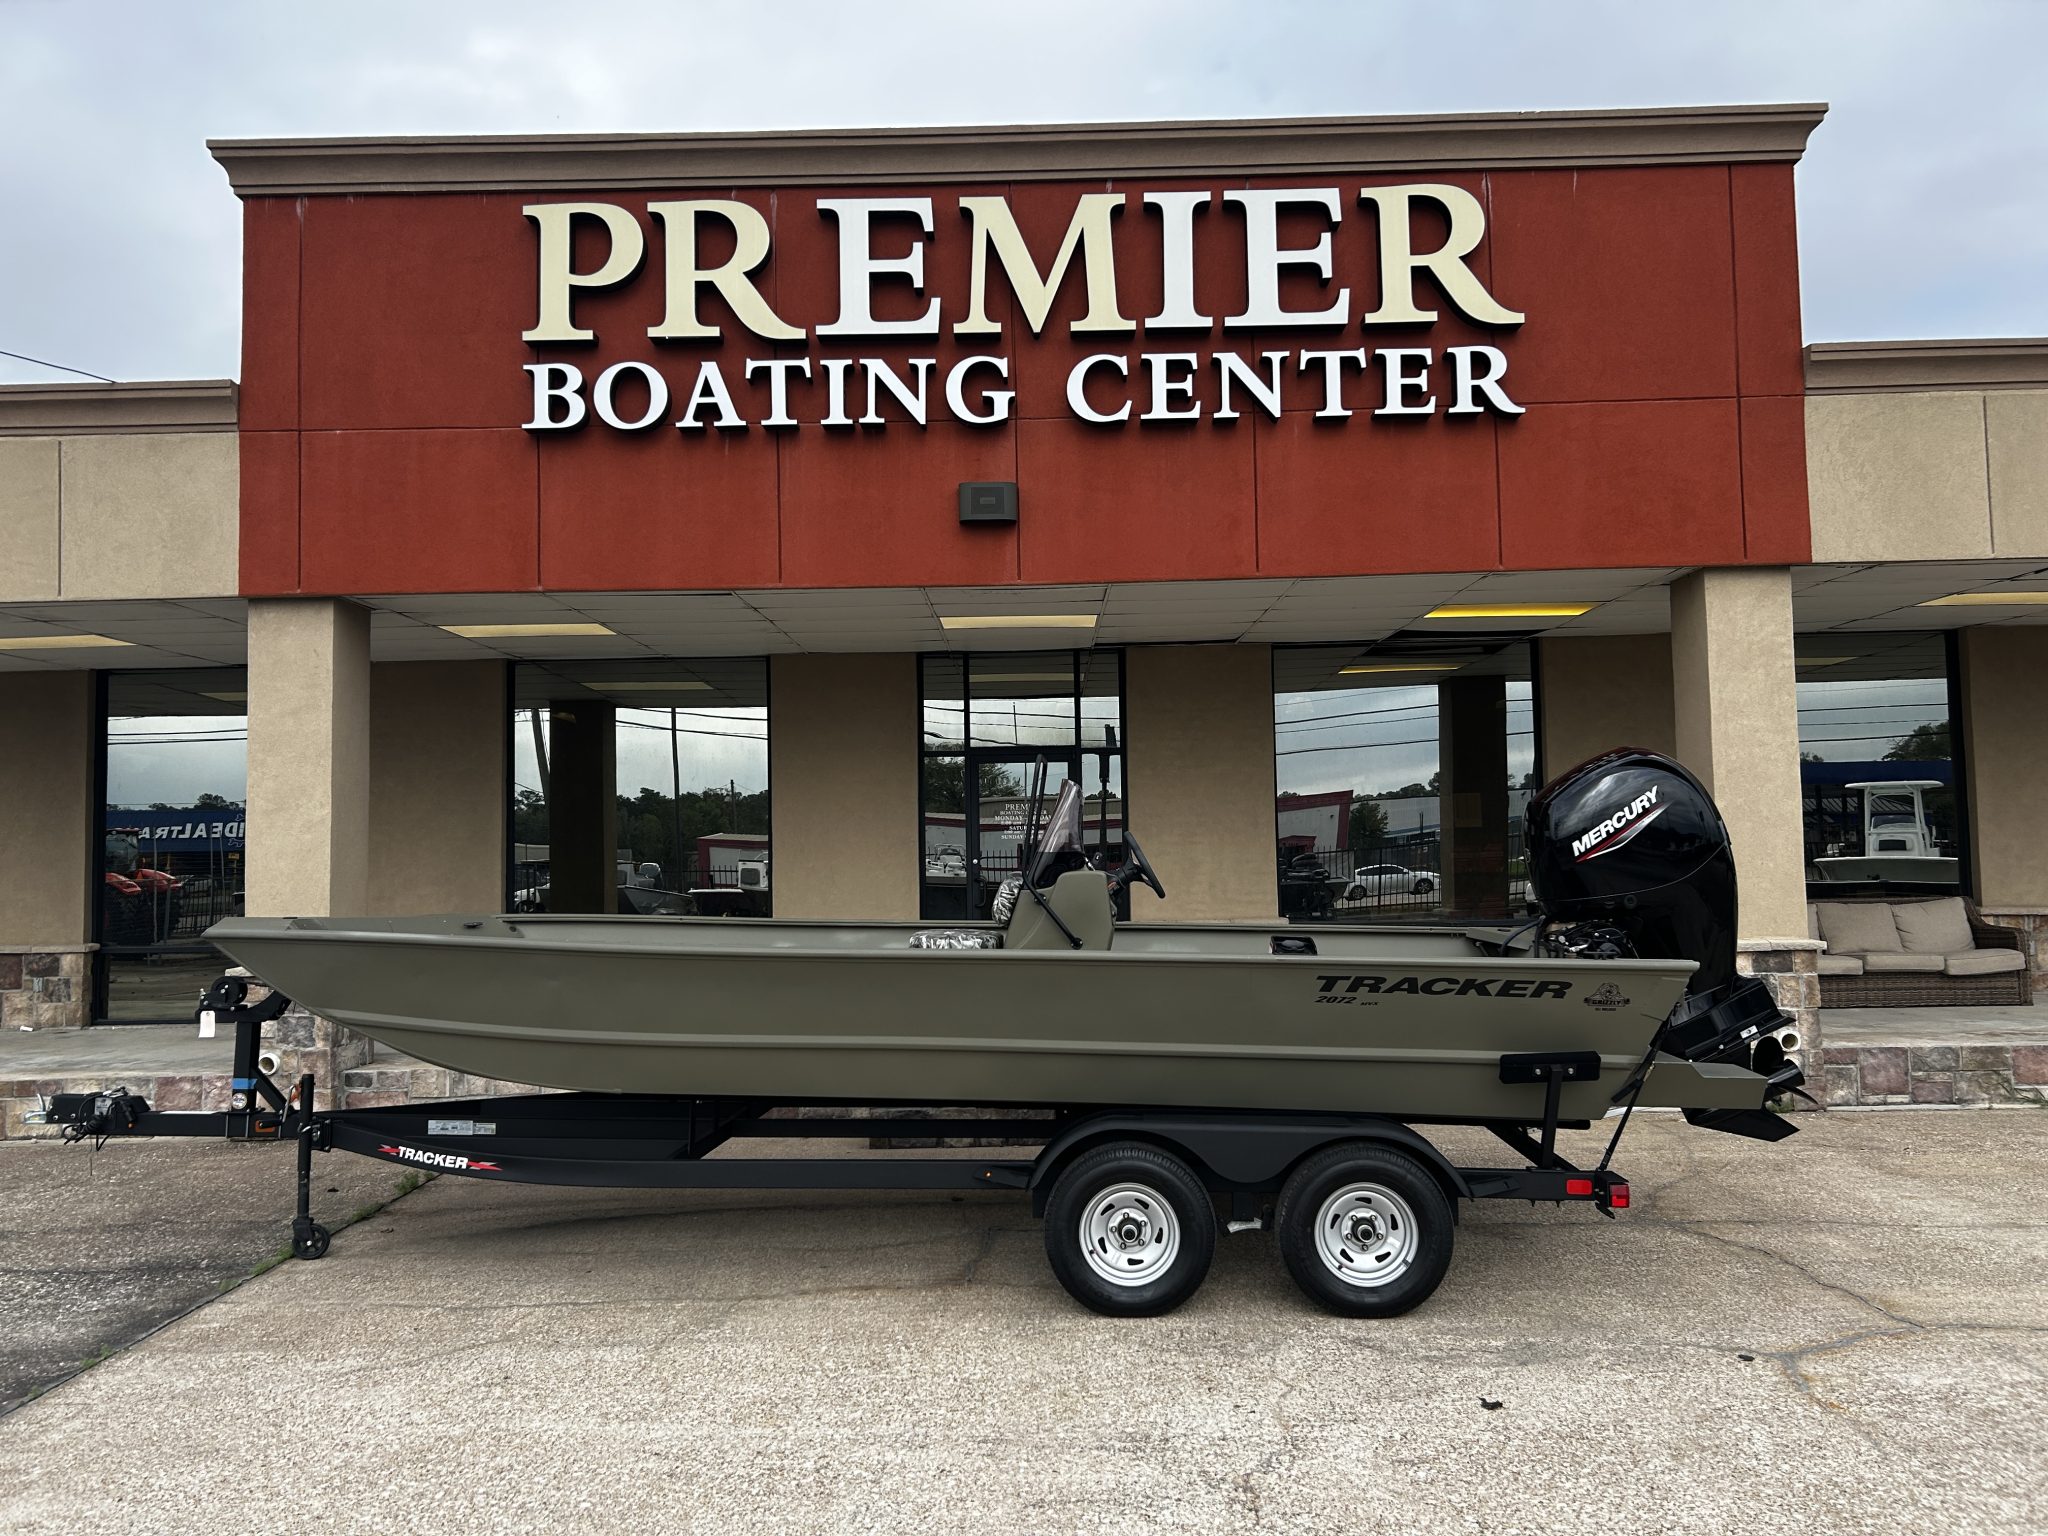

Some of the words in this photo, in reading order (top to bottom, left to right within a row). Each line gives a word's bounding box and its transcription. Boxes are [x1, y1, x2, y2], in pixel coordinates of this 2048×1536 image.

[521, 183, 1526, 342] PREMIER
[521, 356, 1016, 431] BOATING
[1066, 345, 1527, 423] CENTER
[1572, 785, 1658, 857] MERCURY
[1314, 995, 1357, 1004] 2072
[1316, 975, 1573, 999] TRACKER
[398, 1146, 469, 1170] TRACKER
